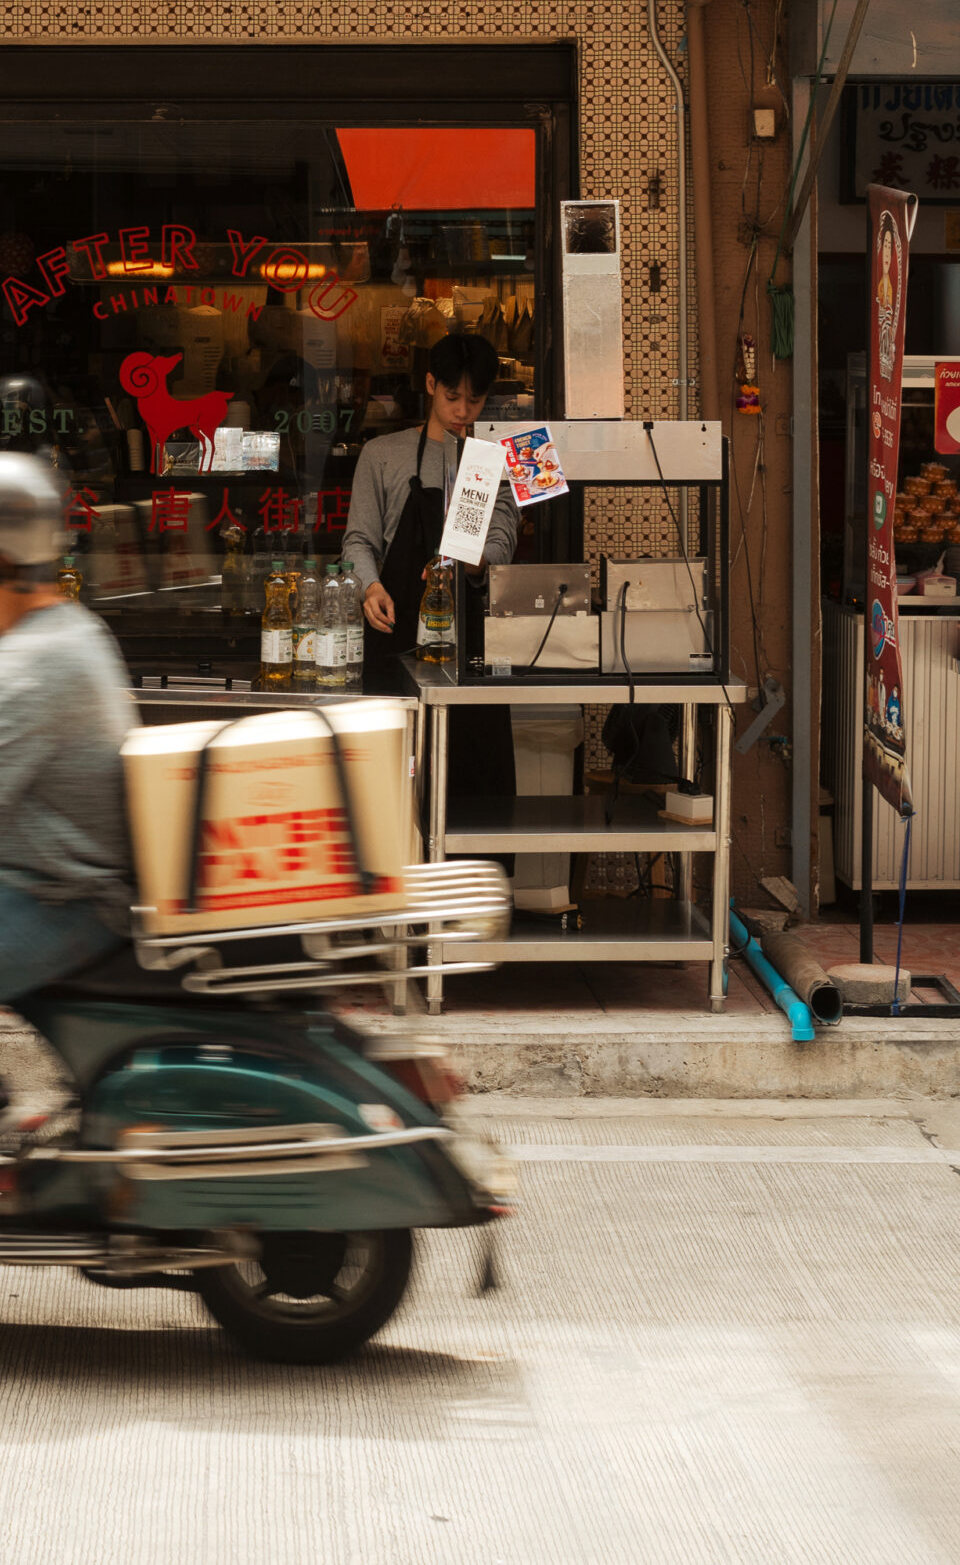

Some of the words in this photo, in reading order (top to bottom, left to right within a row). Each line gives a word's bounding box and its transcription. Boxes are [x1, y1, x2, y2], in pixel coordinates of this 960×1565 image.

[2, 225, 199, 326] AFTER
[227, 229, 358, 322] YOU
[93, 286, 262, 322] CHINATOWN
[1, 409, 84, 434] EST.
[274, 409, 355, 434] 2007
[461, 487, 489, 503] MENU
